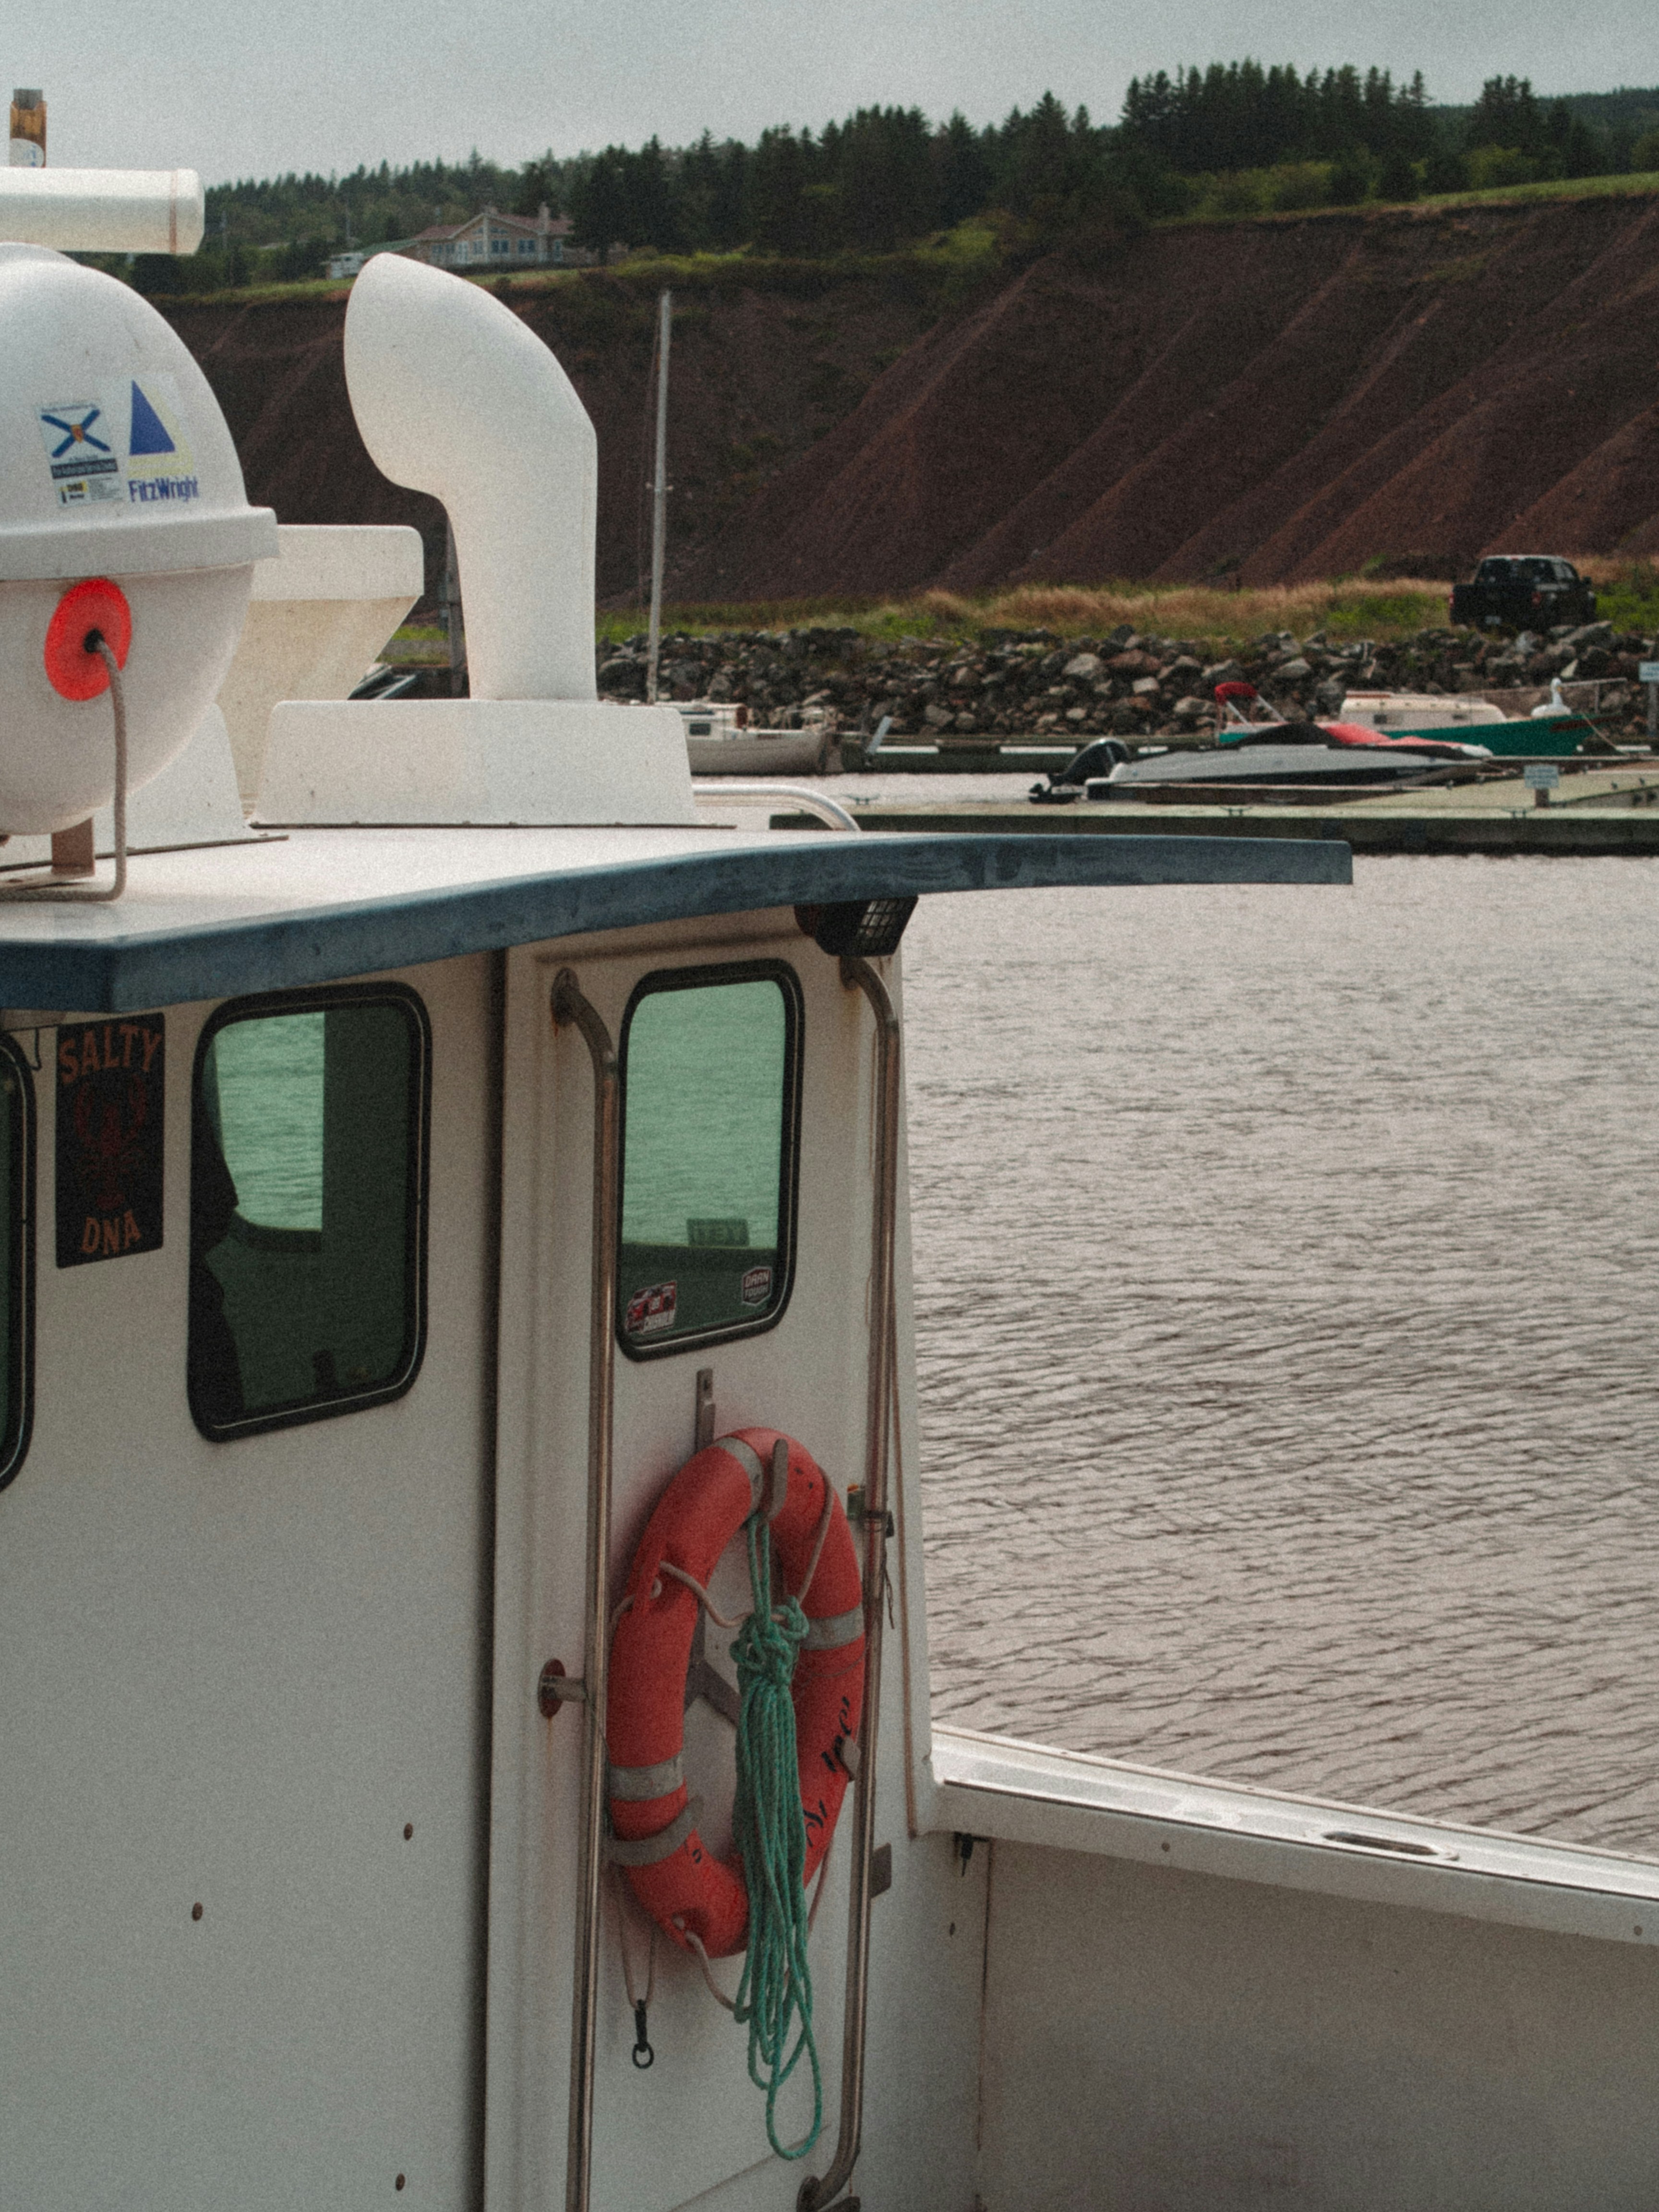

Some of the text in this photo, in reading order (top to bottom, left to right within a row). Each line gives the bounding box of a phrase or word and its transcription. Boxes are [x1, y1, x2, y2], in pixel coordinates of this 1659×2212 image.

[128, 476, 199, 503] FitzWright
[59, 1024, 162, 1085] SALTY
[80, 1209, 142, 1255] DNA
